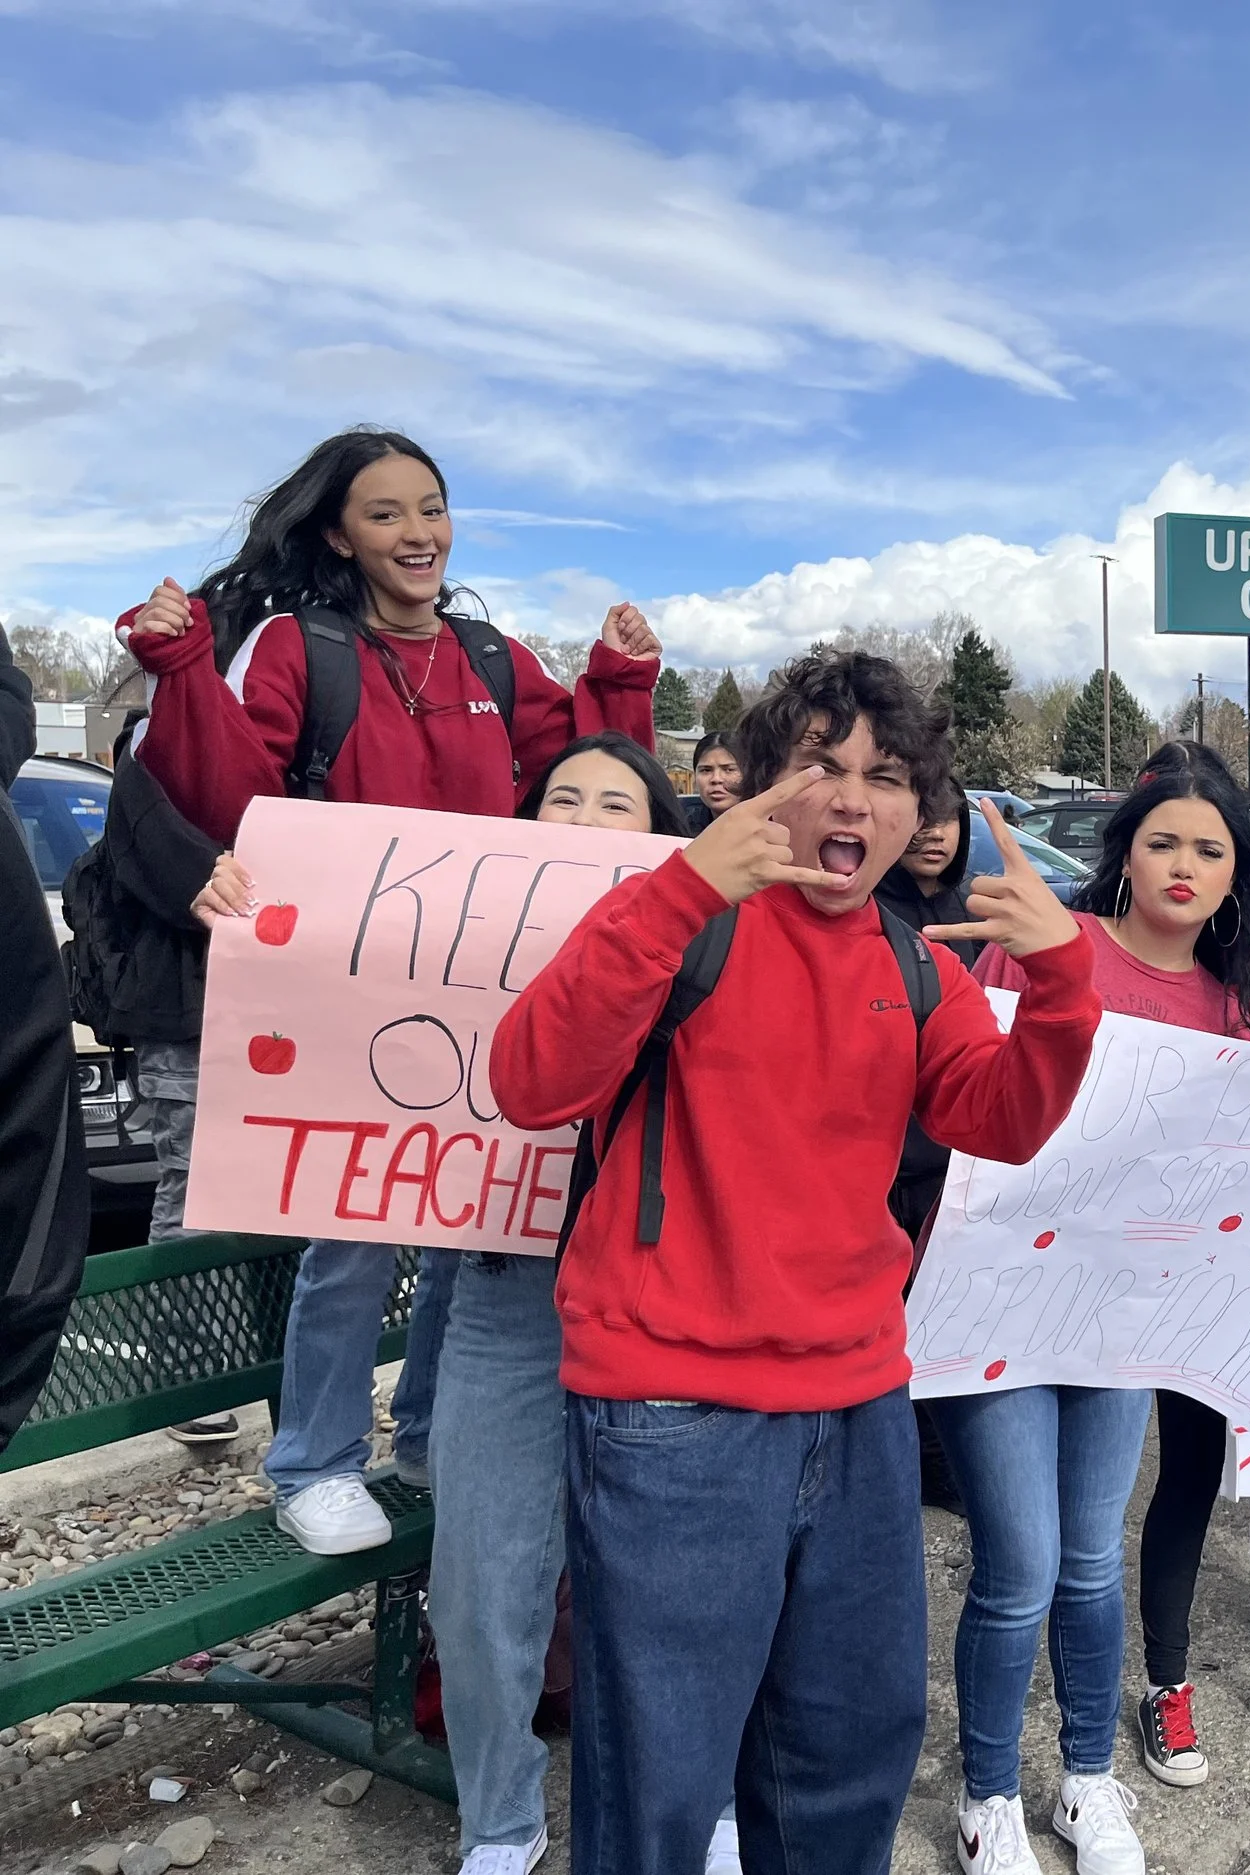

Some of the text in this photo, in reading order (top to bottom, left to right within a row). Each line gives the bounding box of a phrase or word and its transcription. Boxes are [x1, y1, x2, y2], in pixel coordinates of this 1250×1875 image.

[349, 836, 652, 993] KEE
[1079, 1034, 1187, 1143] UR
[242, 1114, 577, 1240] TEACHE
[964, 1149, 1157, 1225] WON'T
[1137, 1147, 1249, 1226] STOP
[907, 1264, 1045, 1362] KEEP
[1023, 1263, 1137, 1367] OUR
